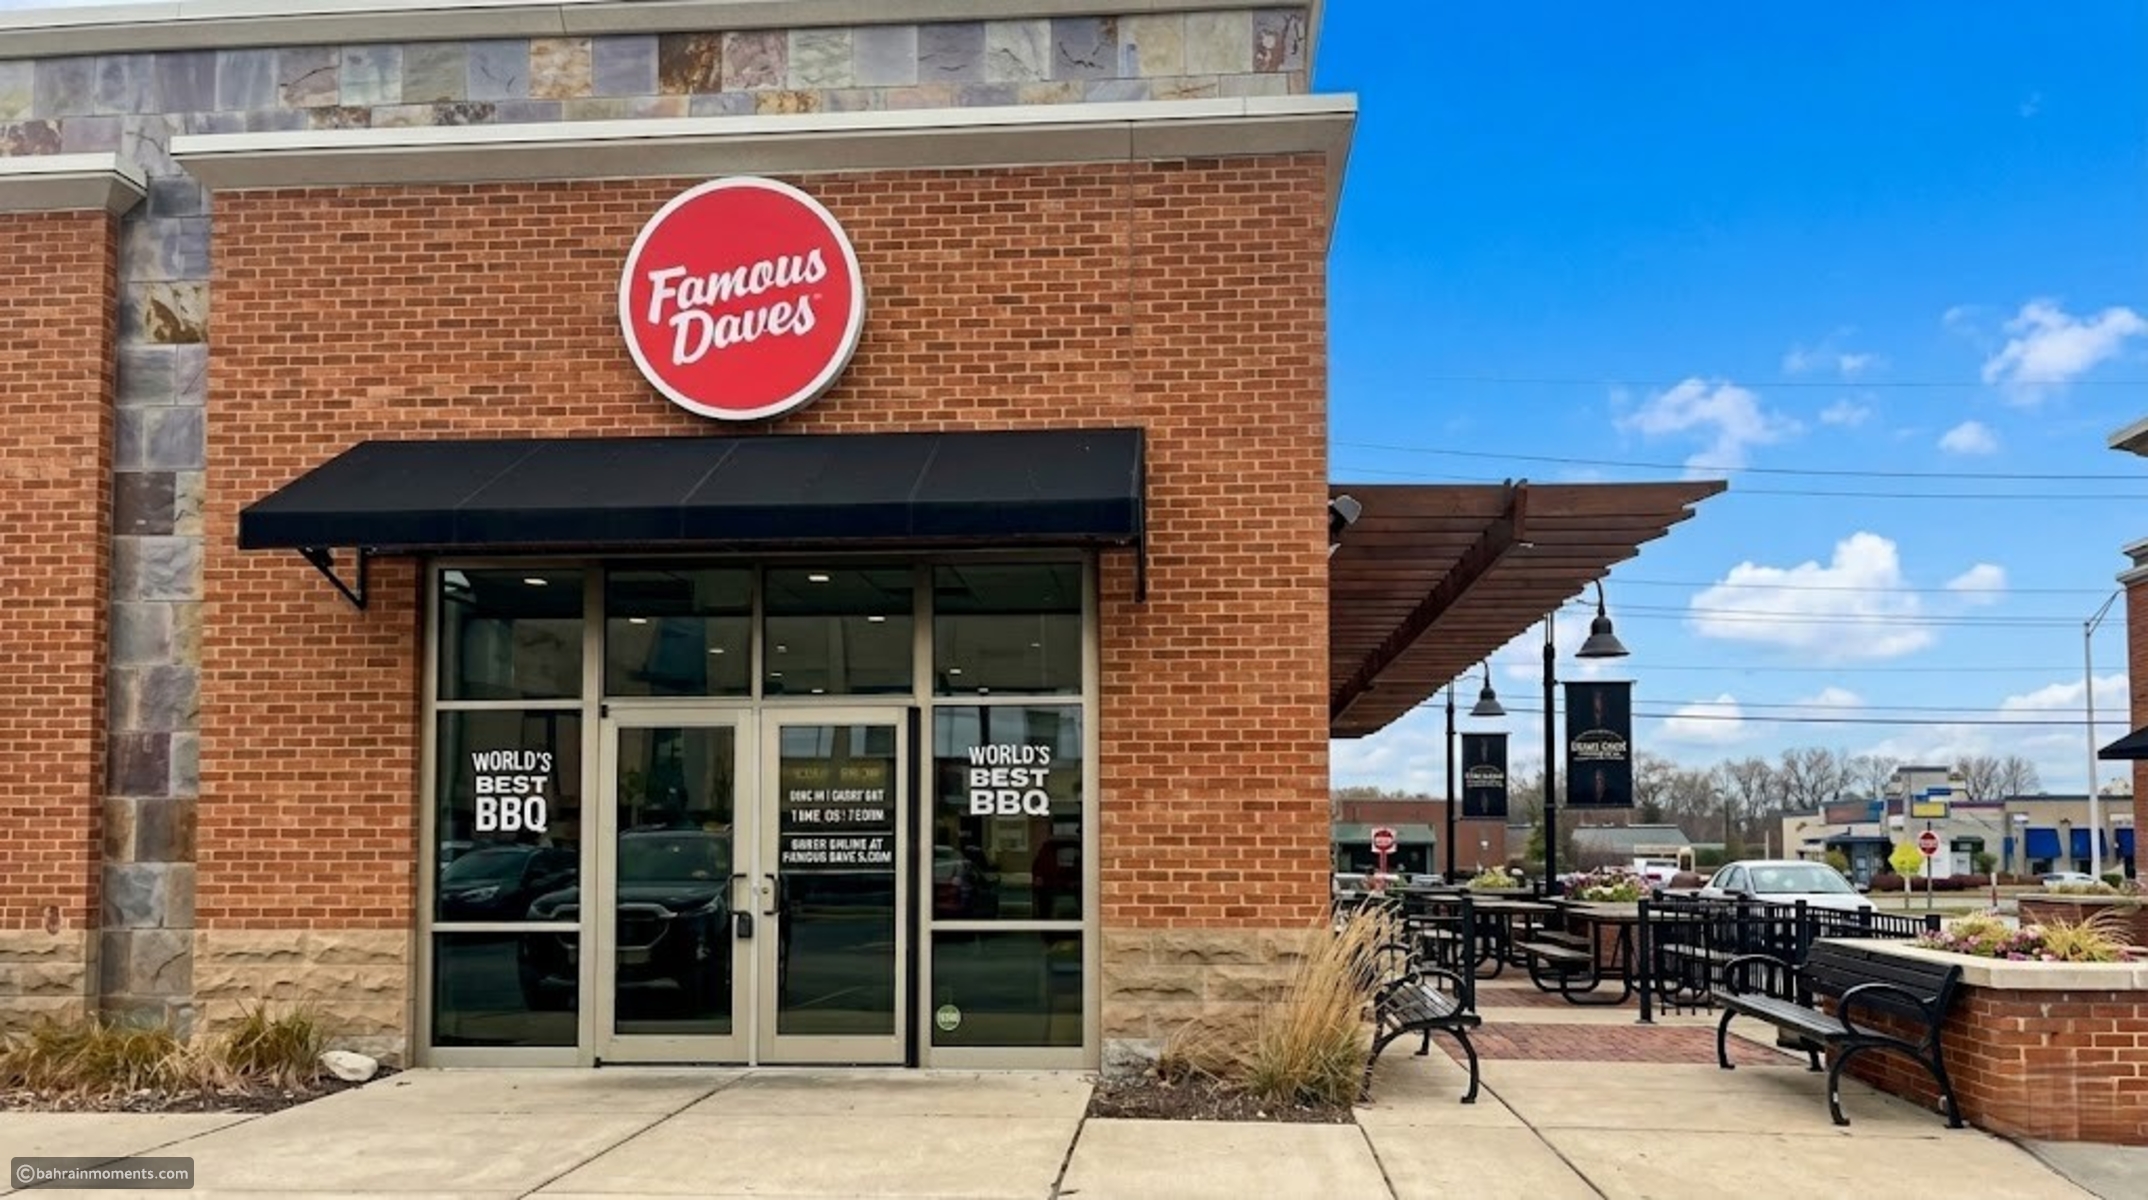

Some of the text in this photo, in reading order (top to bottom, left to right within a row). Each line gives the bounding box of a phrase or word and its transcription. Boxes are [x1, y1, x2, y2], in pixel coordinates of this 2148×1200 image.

[647, 248, 827, 325] Famous
[669, 295, 815, 366] Daves
[471, 750, 553, 773] WORLD'S
[968, 744, 1050, 766] WORLD'S
[475, 775, 548, 794] BEST
[970, 767, 1050, 788] BEST
[475, 796, 547, 833] BBQ
[970, 789, 1050, 816] BBQ
